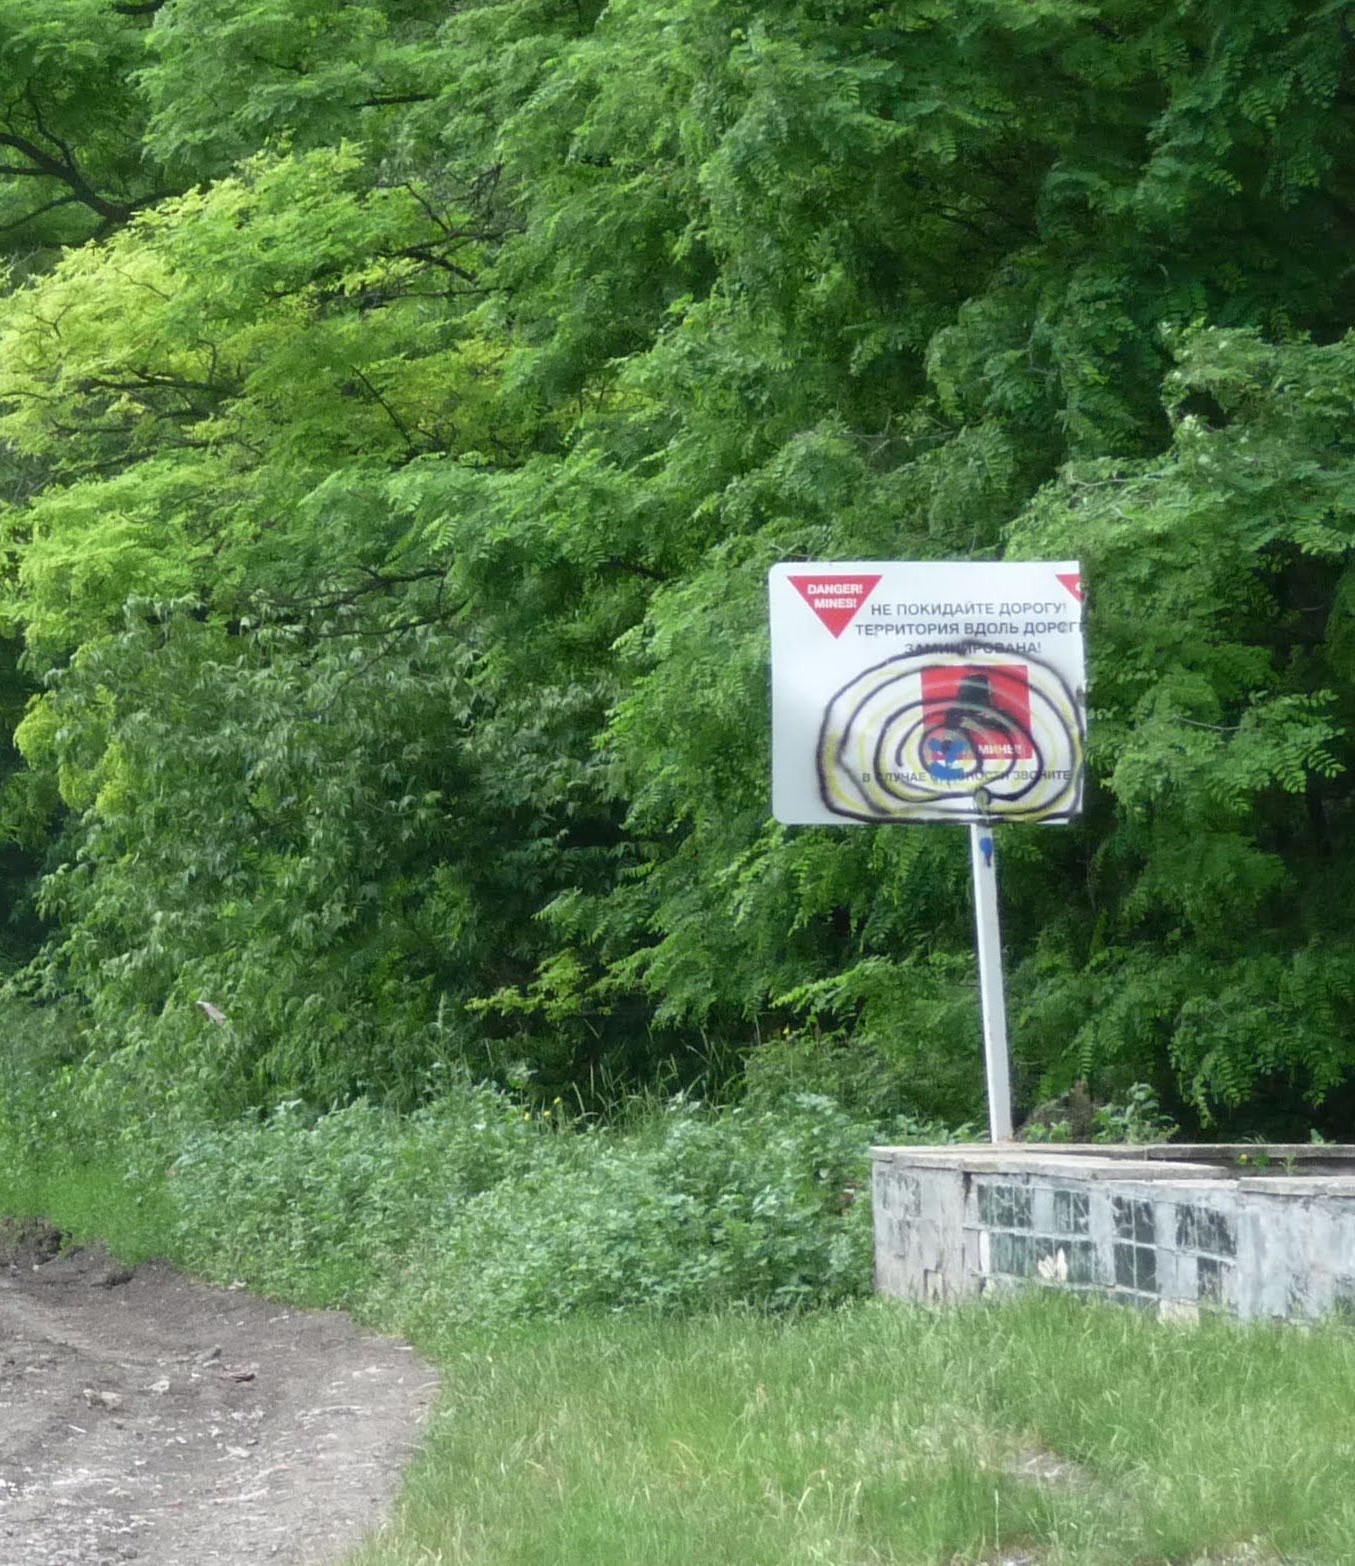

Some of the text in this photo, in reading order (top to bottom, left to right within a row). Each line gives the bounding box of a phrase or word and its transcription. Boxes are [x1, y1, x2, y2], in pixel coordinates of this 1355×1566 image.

[807, 584, 863, 595] DANGER!
[814, 598, 857, 609] MINES!
[871, 600, 1067, 617] НЕ ПОКИДАЙТЕ ДОРОГУ!
[855, 622, 959, 636] ТЕРРИТОРИЯ
[964, 622, 1019, 636] ВДОЛЬ
[862, 772, 871, 783] В
[875, 771, 927, 783] ЛУЧАЕ
